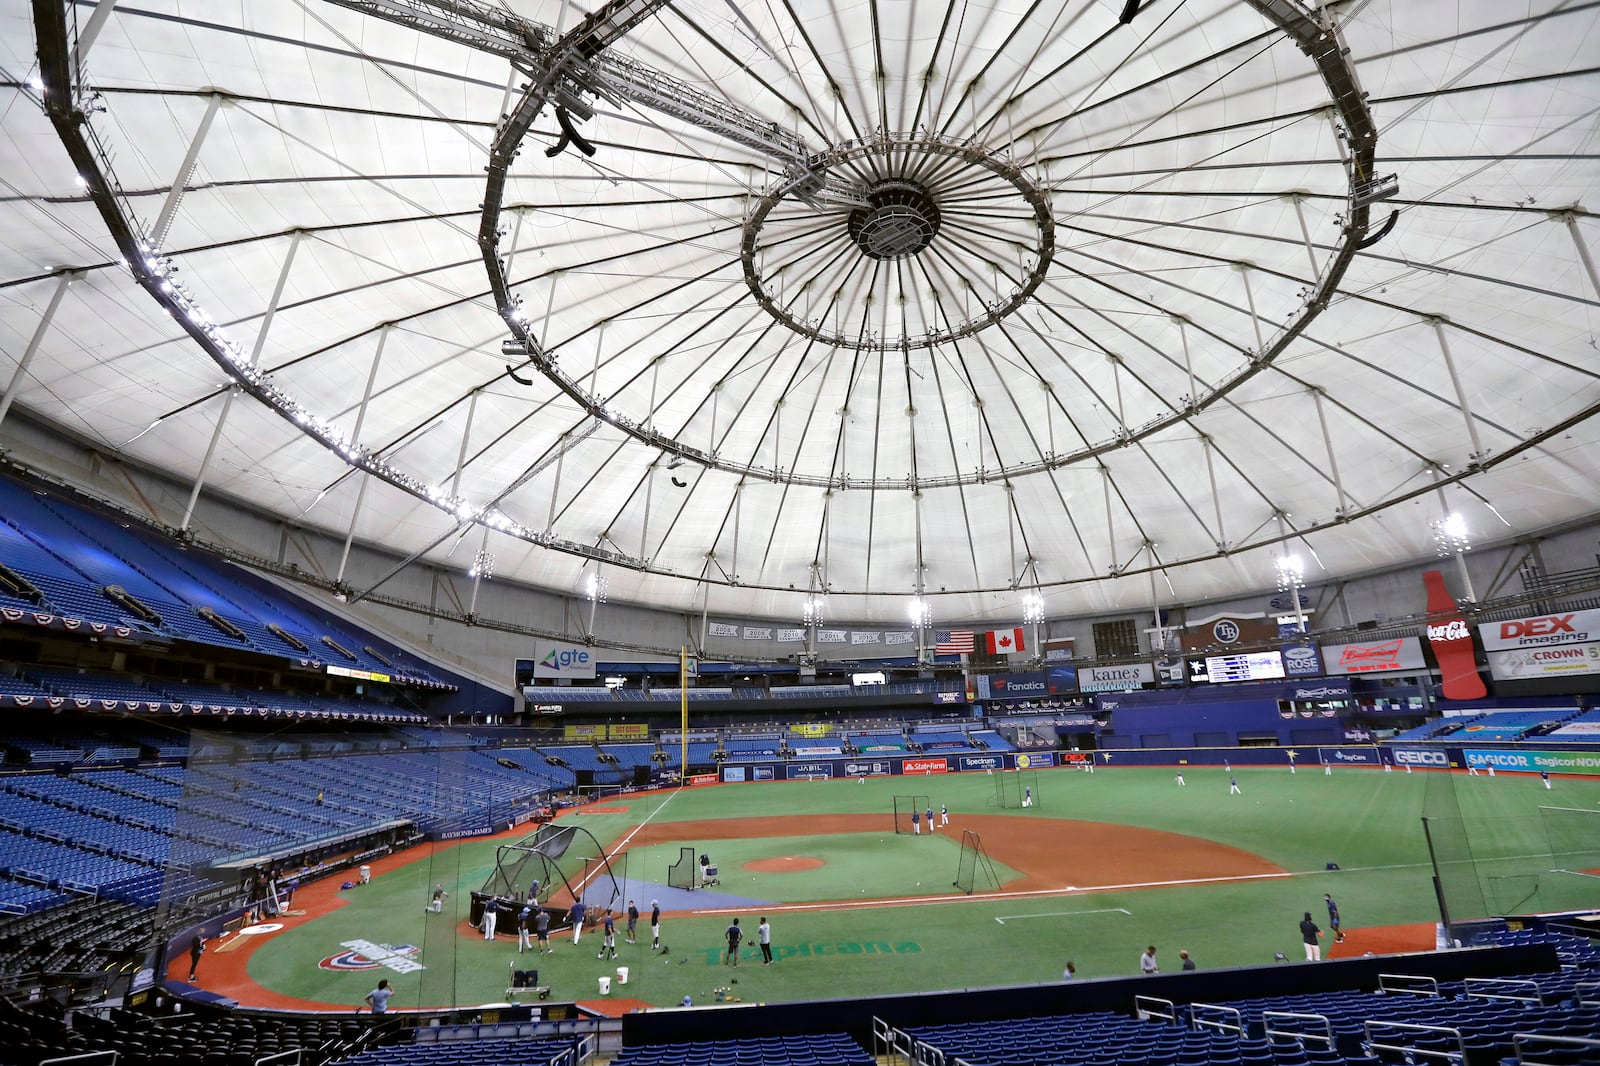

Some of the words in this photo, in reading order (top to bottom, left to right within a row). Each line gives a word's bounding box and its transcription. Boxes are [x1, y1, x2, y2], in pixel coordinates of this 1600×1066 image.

[1500, 614, 1576, 640] DEX
[1519, 632, 1588, 645] imaging
[560, 649, 589, 666] gte
[1533, 649, 1584, 660] CROWN
[1287, 658, 1319, 669] ROSE
[1007, 681, 1045, 691] Fanatics
[966, 758, 995, 766] Spectrum
[1064, 753, 1087, 761] DEX
[1395, 751, 1447, 765] GEICO
[1468, 754, 1529, 766] SAGICOR
[441, 829, 472, 840] RAYMOND
[472, 827, 493, 837] JAMES
